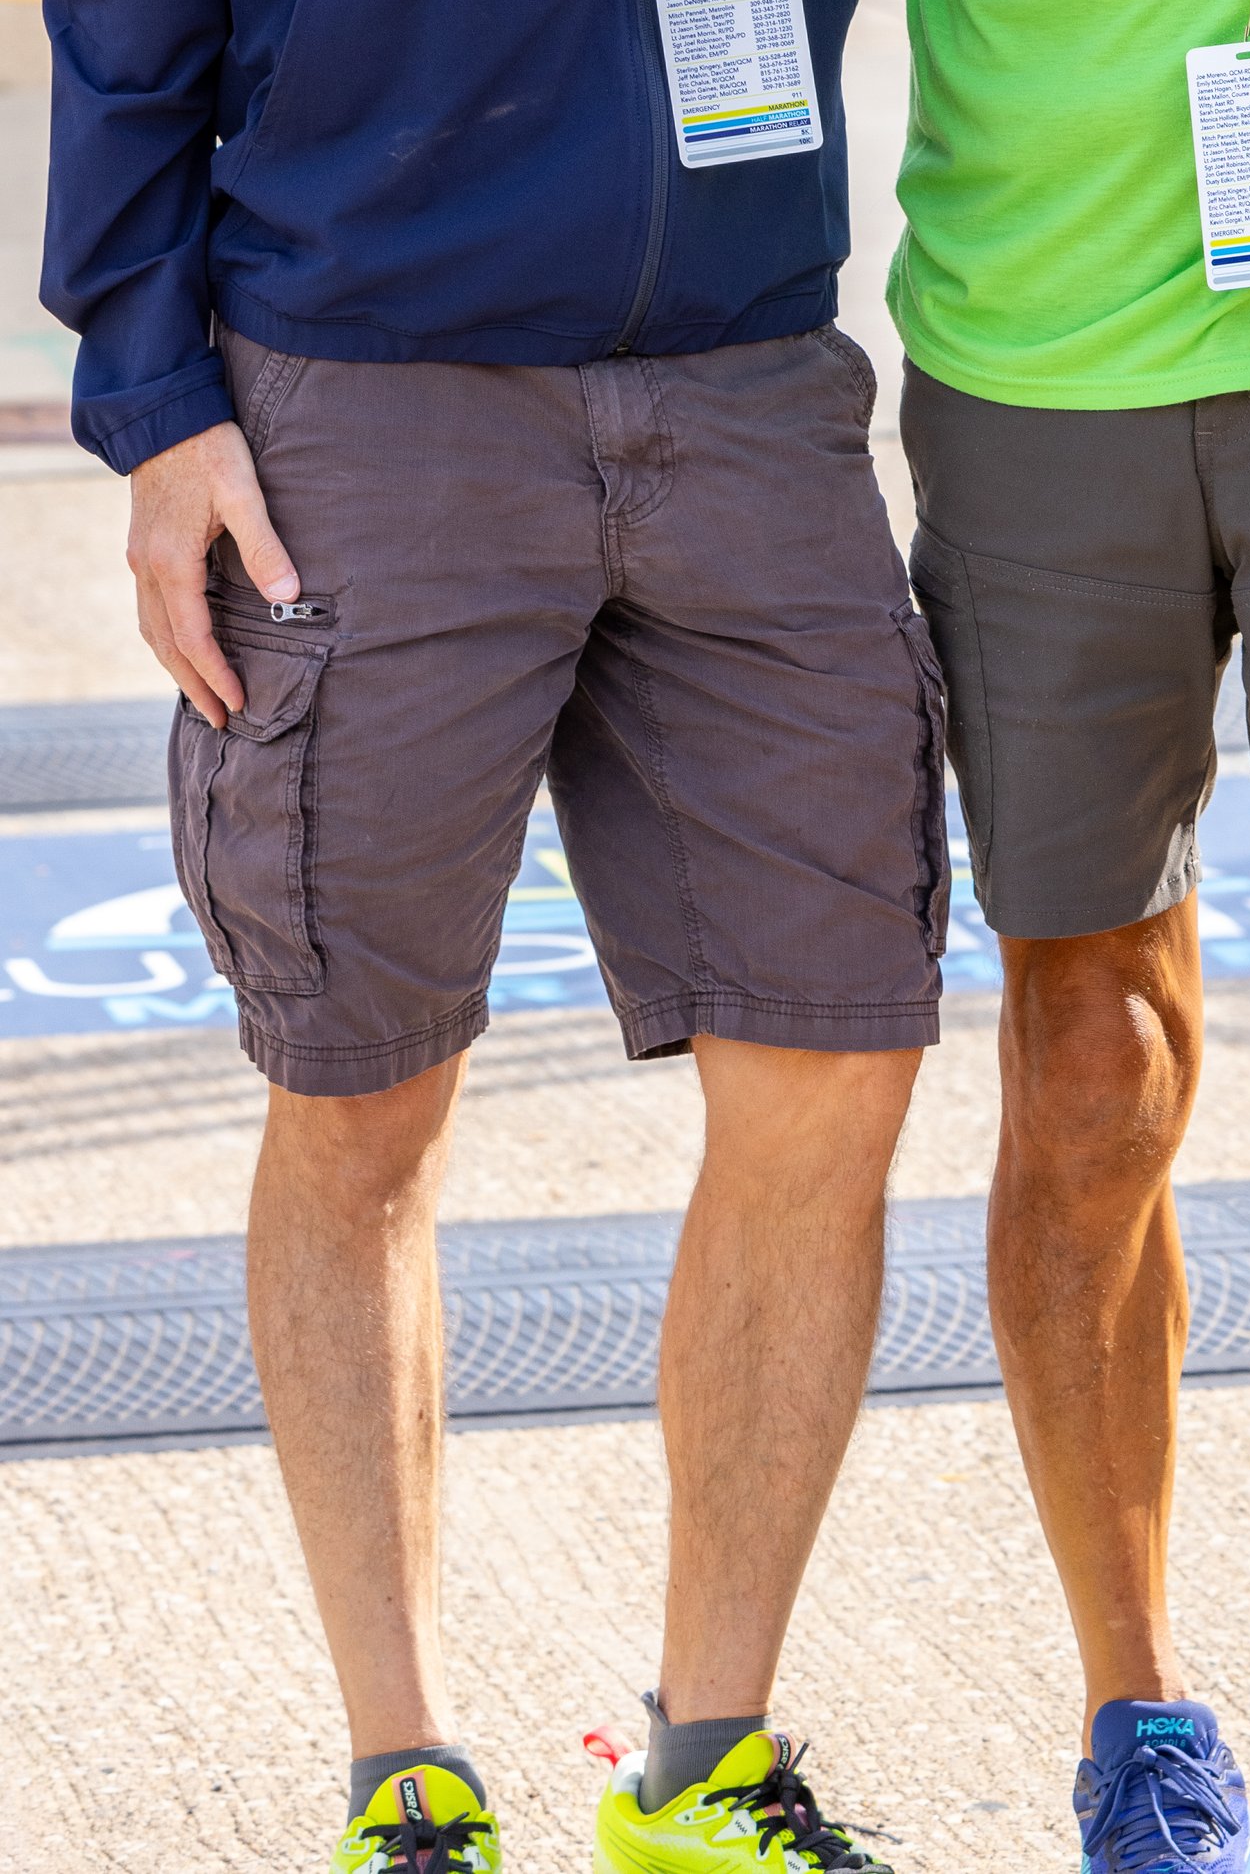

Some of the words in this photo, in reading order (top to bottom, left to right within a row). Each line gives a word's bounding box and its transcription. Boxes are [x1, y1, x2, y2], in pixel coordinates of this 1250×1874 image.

[669, 18, 688, 26] Patrick
[676, 25, 693, 33] Jason
[677, 32, 696, 40] James
[679, 88, 695, 96] Robin
[680, 95, 696, 103] Kevin
[682, 103, 720, 115] EMERGENCY
[768, 100, 804, 111] MARATHON
[768, 109, 806, 120] MARATHON
[749, 122, 787, 133] MARATHON
[788, 118, 807, 127] RELAY
[1210, 227, 1244, 238] EMERGENCY
[1136, 1717, 1195, 1737] HOKA
[403, 1781, 418, 1808] asics
